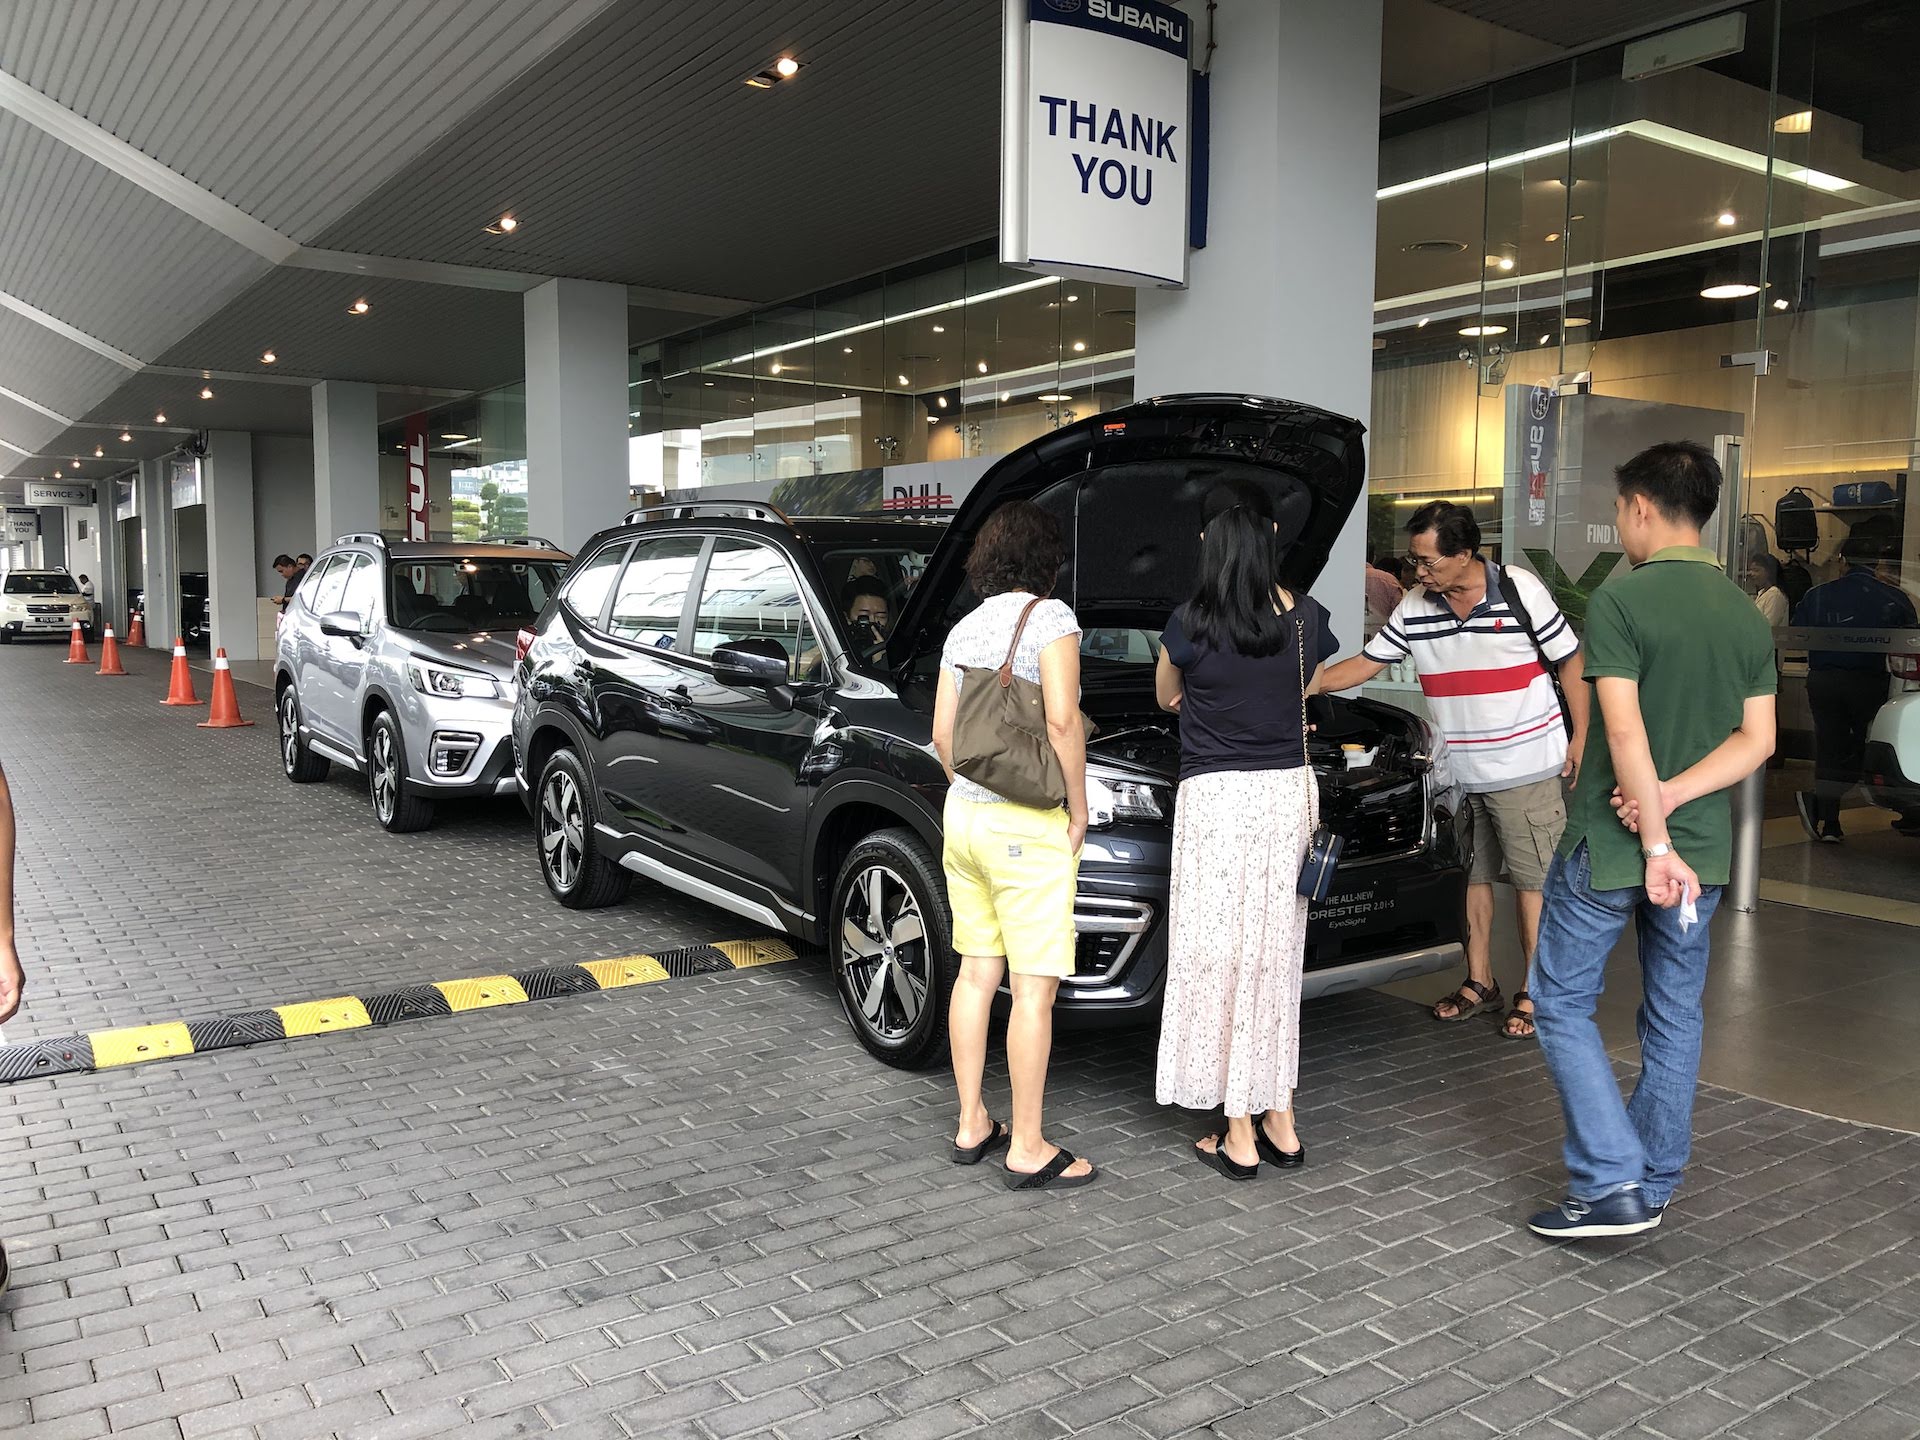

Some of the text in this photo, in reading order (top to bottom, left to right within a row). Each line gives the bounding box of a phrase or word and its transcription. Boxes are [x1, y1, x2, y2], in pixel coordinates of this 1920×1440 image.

[1087, 0, 1183, 43] SUBARU
[1039, 95, 1178, 164] THANK
[1072, 153, 1152, 206] YOU
[33, 490, 73, 498] SERVICE
[893, 482, 948, 518] DULL
[1586, 524, 1623, 545] FIND Y
[1843, 636, 1891, 644] SUBARU
[1340, 890, 1374, 904] ALL-NEW
[1309, 903, 1372, 921] ORESTER
[1328, 917, 1367, 930] EyeSight
